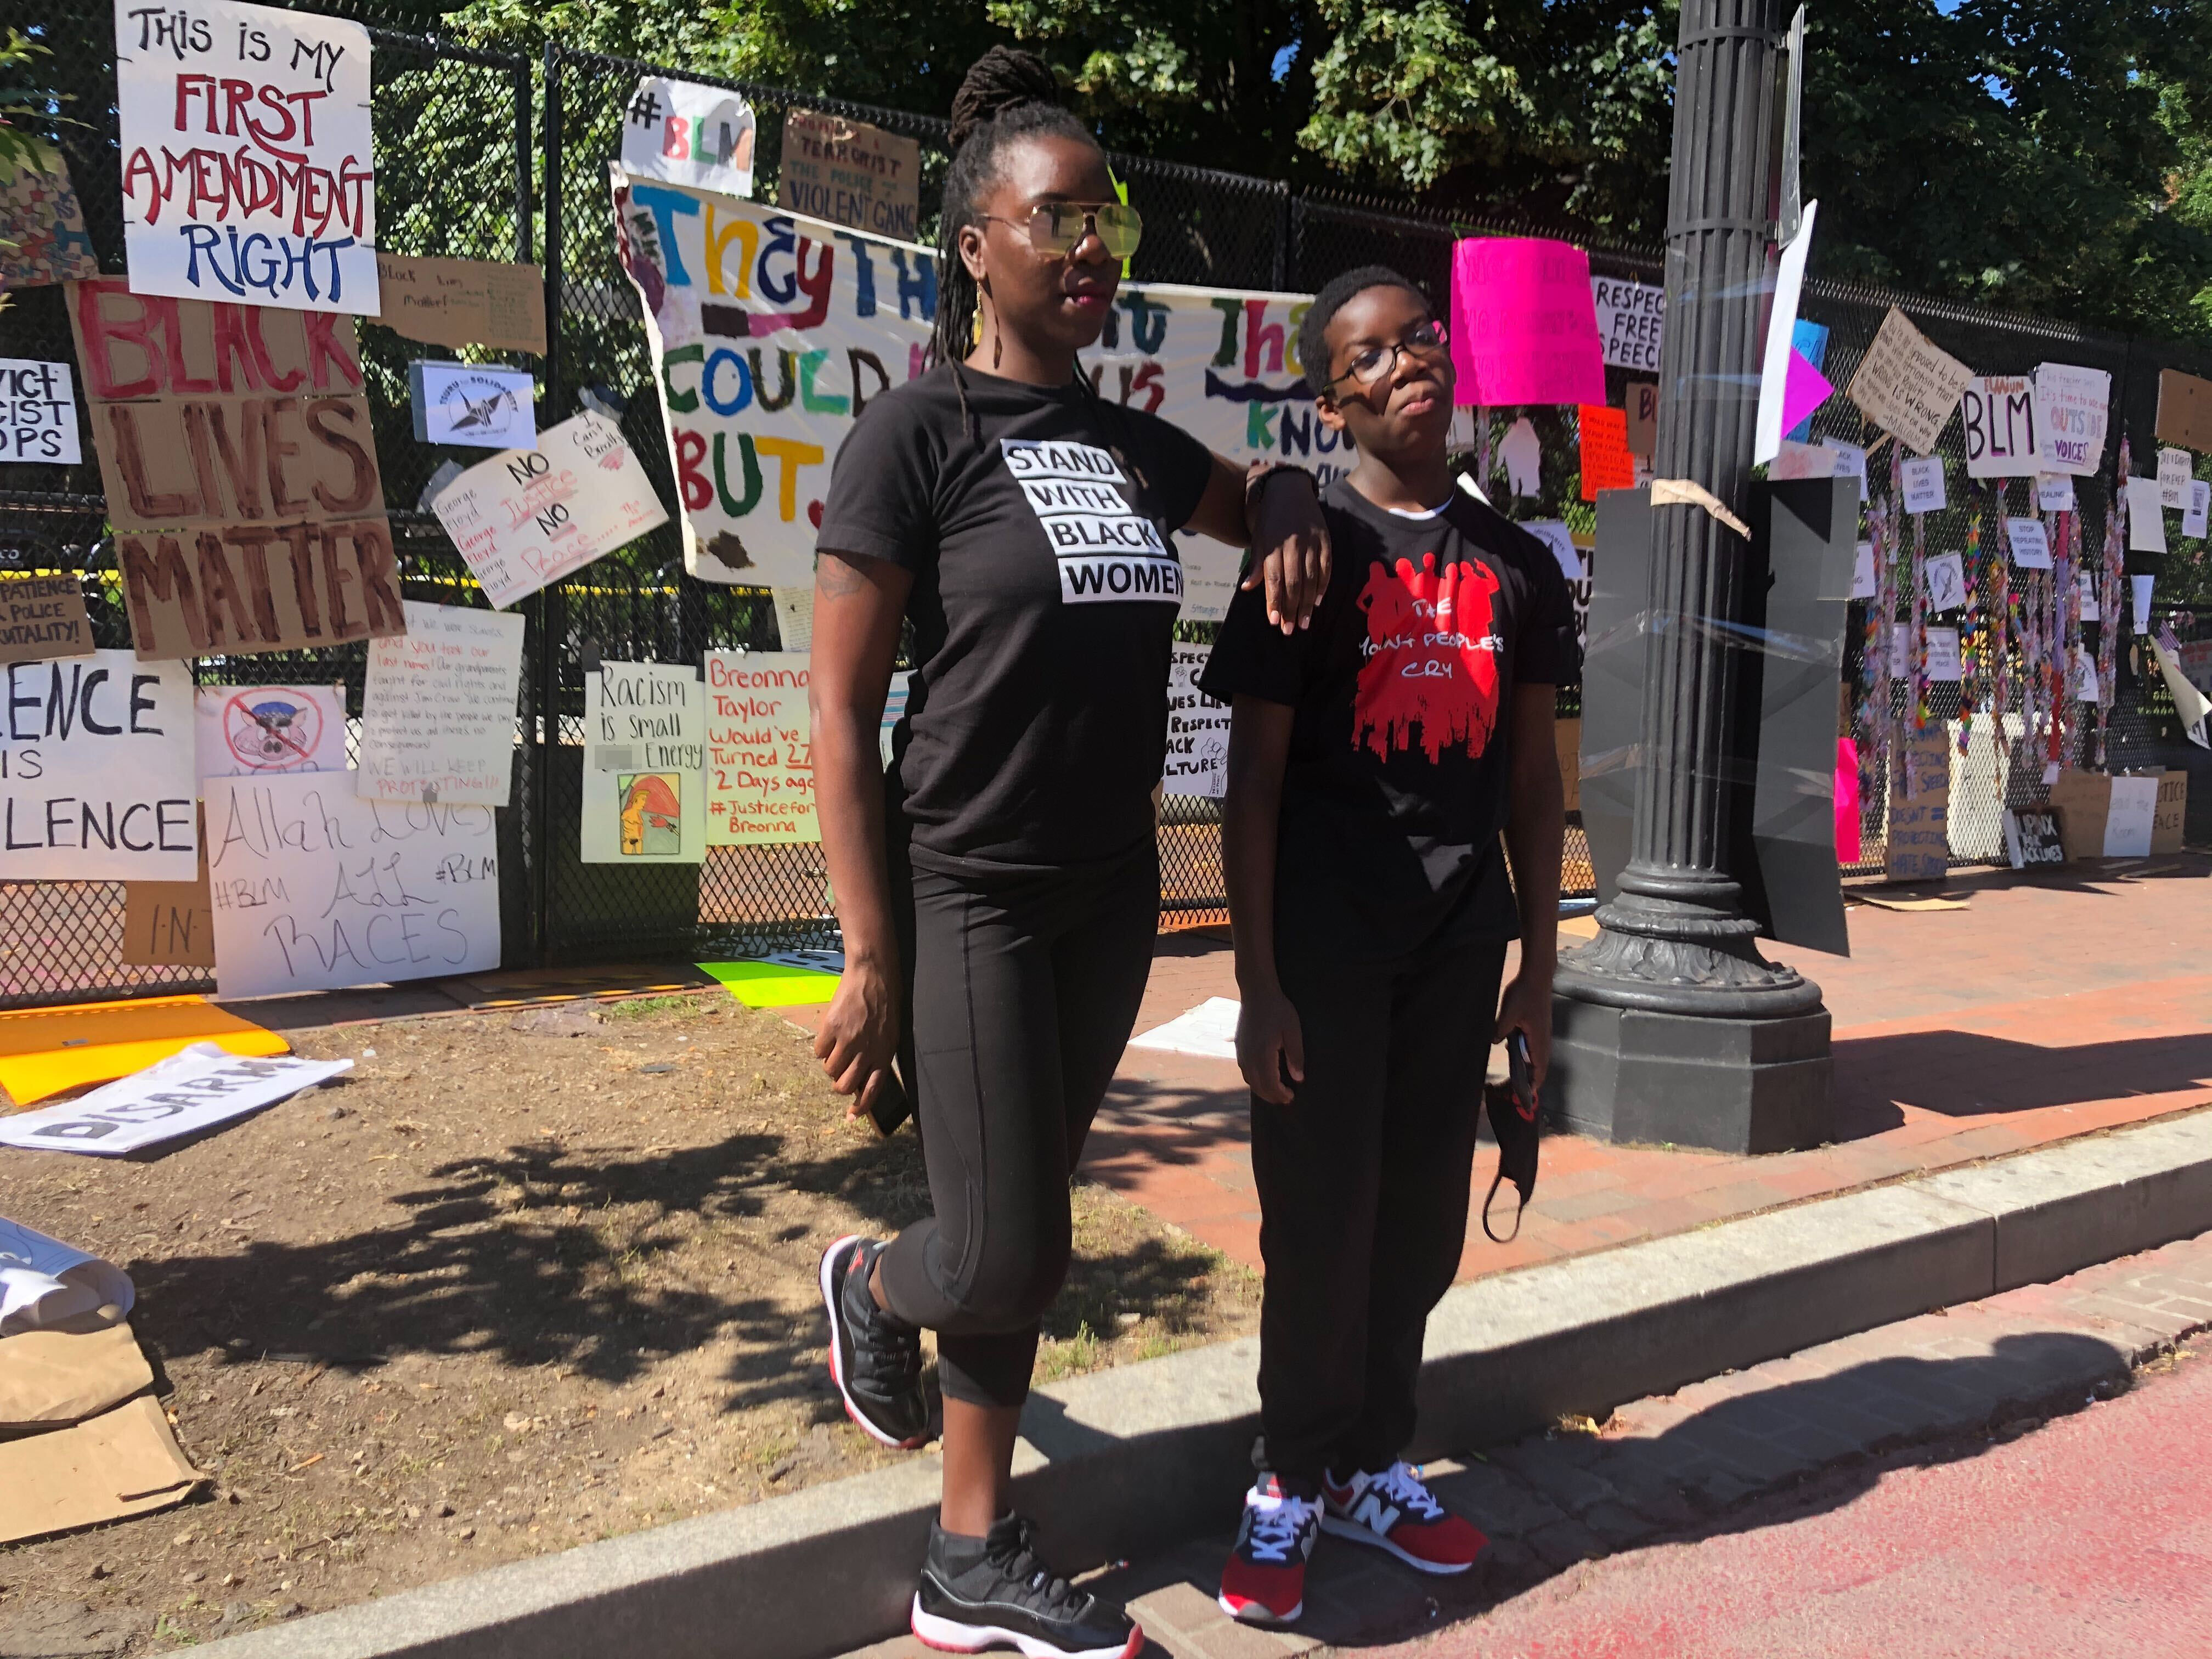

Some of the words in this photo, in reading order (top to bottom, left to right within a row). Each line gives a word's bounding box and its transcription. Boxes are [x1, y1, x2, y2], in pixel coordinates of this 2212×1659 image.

[128, 7, 212, 60] THIS
[239, 22, 271, 60] IS
[290, 38, 345, 92] MY
[174, 73, 328, 164] FIRST
[122, 145, 373, 239] AMENDMENT
[789, 180, 872, 225] VIOLENT
[873, 200, 916, 236] GANG
[180, 224, 355, 303] RIGHT
[78, 281, 363, 398] BLACK
[1613, 313, 1662, 343] FREE
[663, 343, 891, 417] COULD
[1963, 391, 2035, 461] BLM
[2050, 407, 2103, 439] OUTSIDE
[109, 398, 379, 519] LIVES
[1007, 445, 1115, 475] STAND
[2055, 440, 2089, 462] VOICES
[506, 453, 549, 485] NO
[1030, 483, 1123, 509] WITH
[535, 503, 569, 536] NO
[1049, 519, 1162, 548] BLACK
[0, 578, 77, 603] PATIENCE
[122, 522, 406, 651] MATTER
[1065, 562, 1183, 595] WOMEN
[10, 602, 66, 623] POLICE
[410, 640, 436, 654] you
[1423, 630, 1504, 653] PEOPLE'S
[710, 658, 810, 689] Breonna
[1401, 661, 1453, 679] CRY
[0, 661, 165, 741] ENCE
[600, 665, 686, 708] Racism
[713, 694, 782, 723] Taylor
[1171, 715, 1232, 734] RESPECT
[601, 714, 616, 741] is
[2, 748, 43, 780] IS
[368, 757, 396, 776] WE
[402, 759, 439, 775] WILL
[646, 742, 703, 770] Energy
[709, 747, 777, 767] Turned
[786, 743, 811, 765] 27
[715, 770, 732, 790] 2
[737, 771, 780, 798] Days
[5, 797, 193, 852] LENCE
[214, 786, 353, 868] Allah
[730, 816, 797, 833] Breonna
[435, 855, 497, 885] #BLM
[216, 877, 292, 911] #BLM
[263, 907, 469, 978] RACES
[31, 1060, 305, 1139] DISARM
